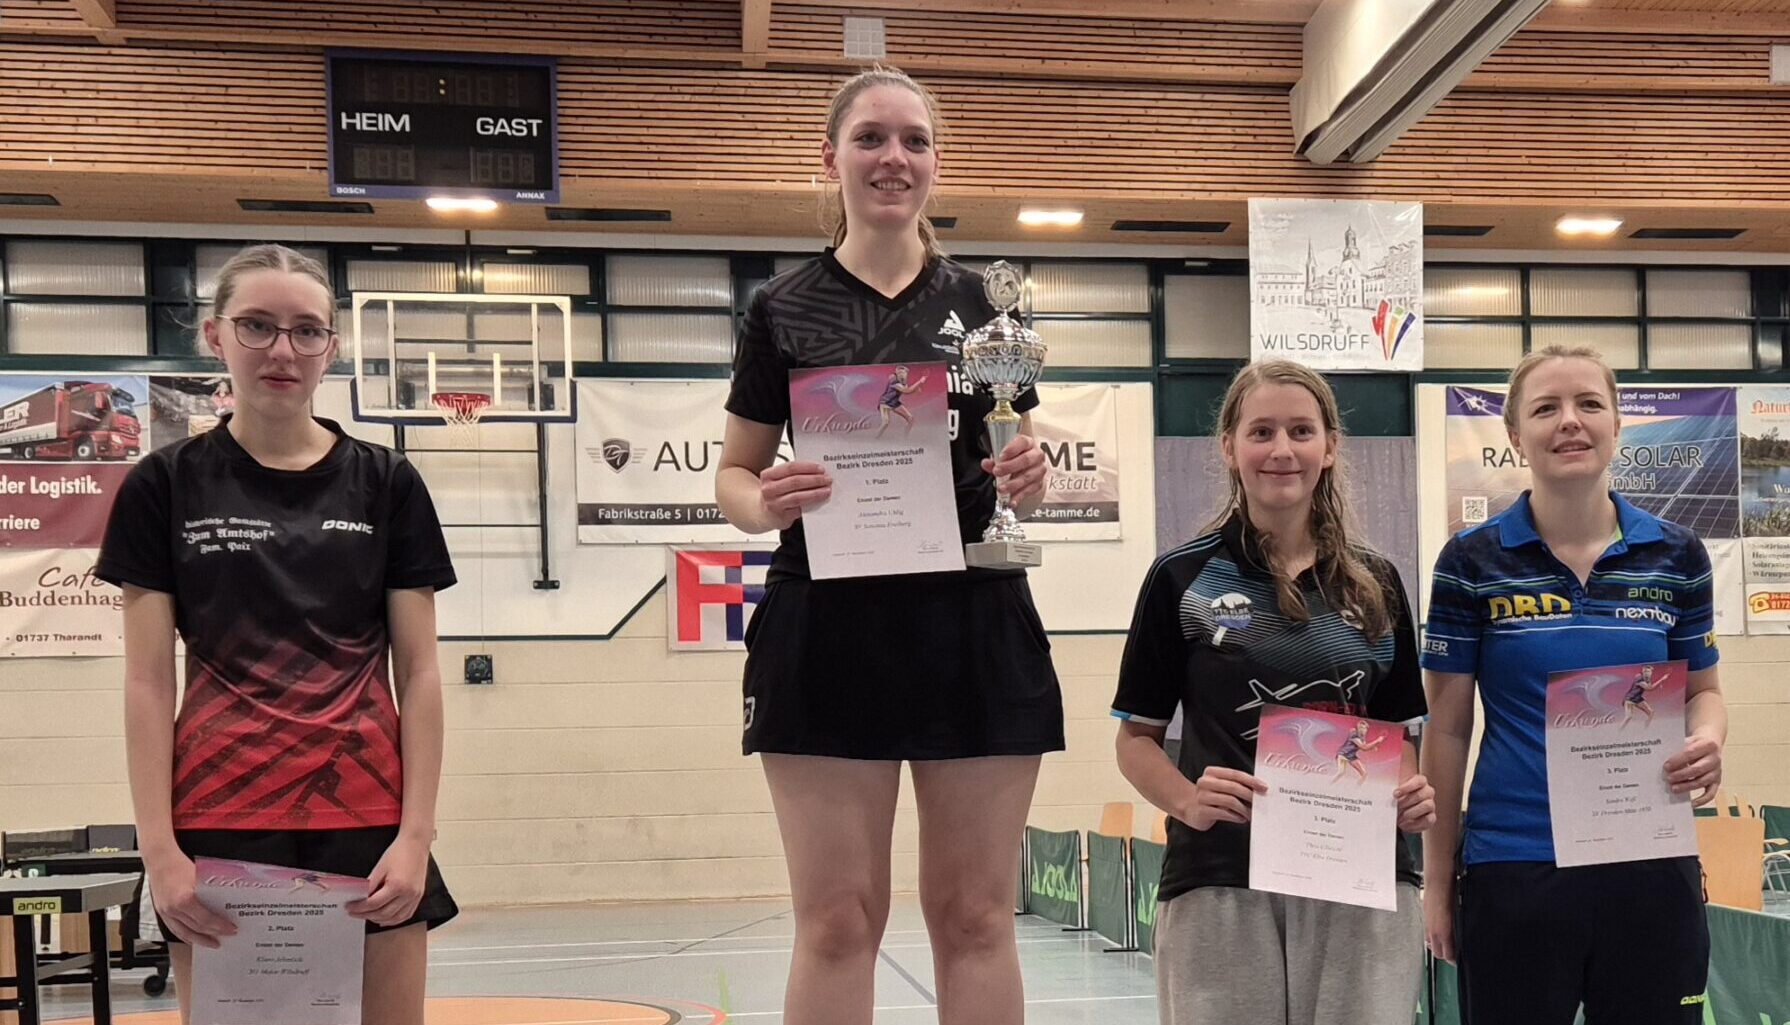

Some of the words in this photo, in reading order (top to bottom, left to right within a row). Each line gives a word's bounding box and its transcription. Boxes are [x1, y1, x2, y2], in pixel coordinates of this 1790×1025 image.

[341, 111, 411, 132] HEIM
[476, 117, 542, 137] GAST
[336, 186, 366, 195] BOSCH
[1260, 333, 1370, 351] WILSDRUFF
[1622, 392, 1637, 400] und
[1040, 442, 1096, 471] ME
[1620, 445, 1703, 467] SOLAR
[862, 460, 893, 468] Dresden
[0, 475, 25, 494] der
[30, 475, 102, 498] Logistik.
[1048, 475, 1097, 490] kstatt
[598, 508, 671, 519] Fabrikstraße
[675, 509, 681, 519] 5
[322, 519, 373, 534] DONIC
[0, 590, 123, 611] Buddenhag
[1628, 587, 1673, 601] andro
[16, 634, 49, 642] 01737
[53, 633, 102, 641] Tharandt
[1605, 750, 1633, 758] Dresden
[1290, 797, 1311, 805] Bezirk
[1313, 801, 1343, 810] Dresden
[18, 901, 56, 911] andro
